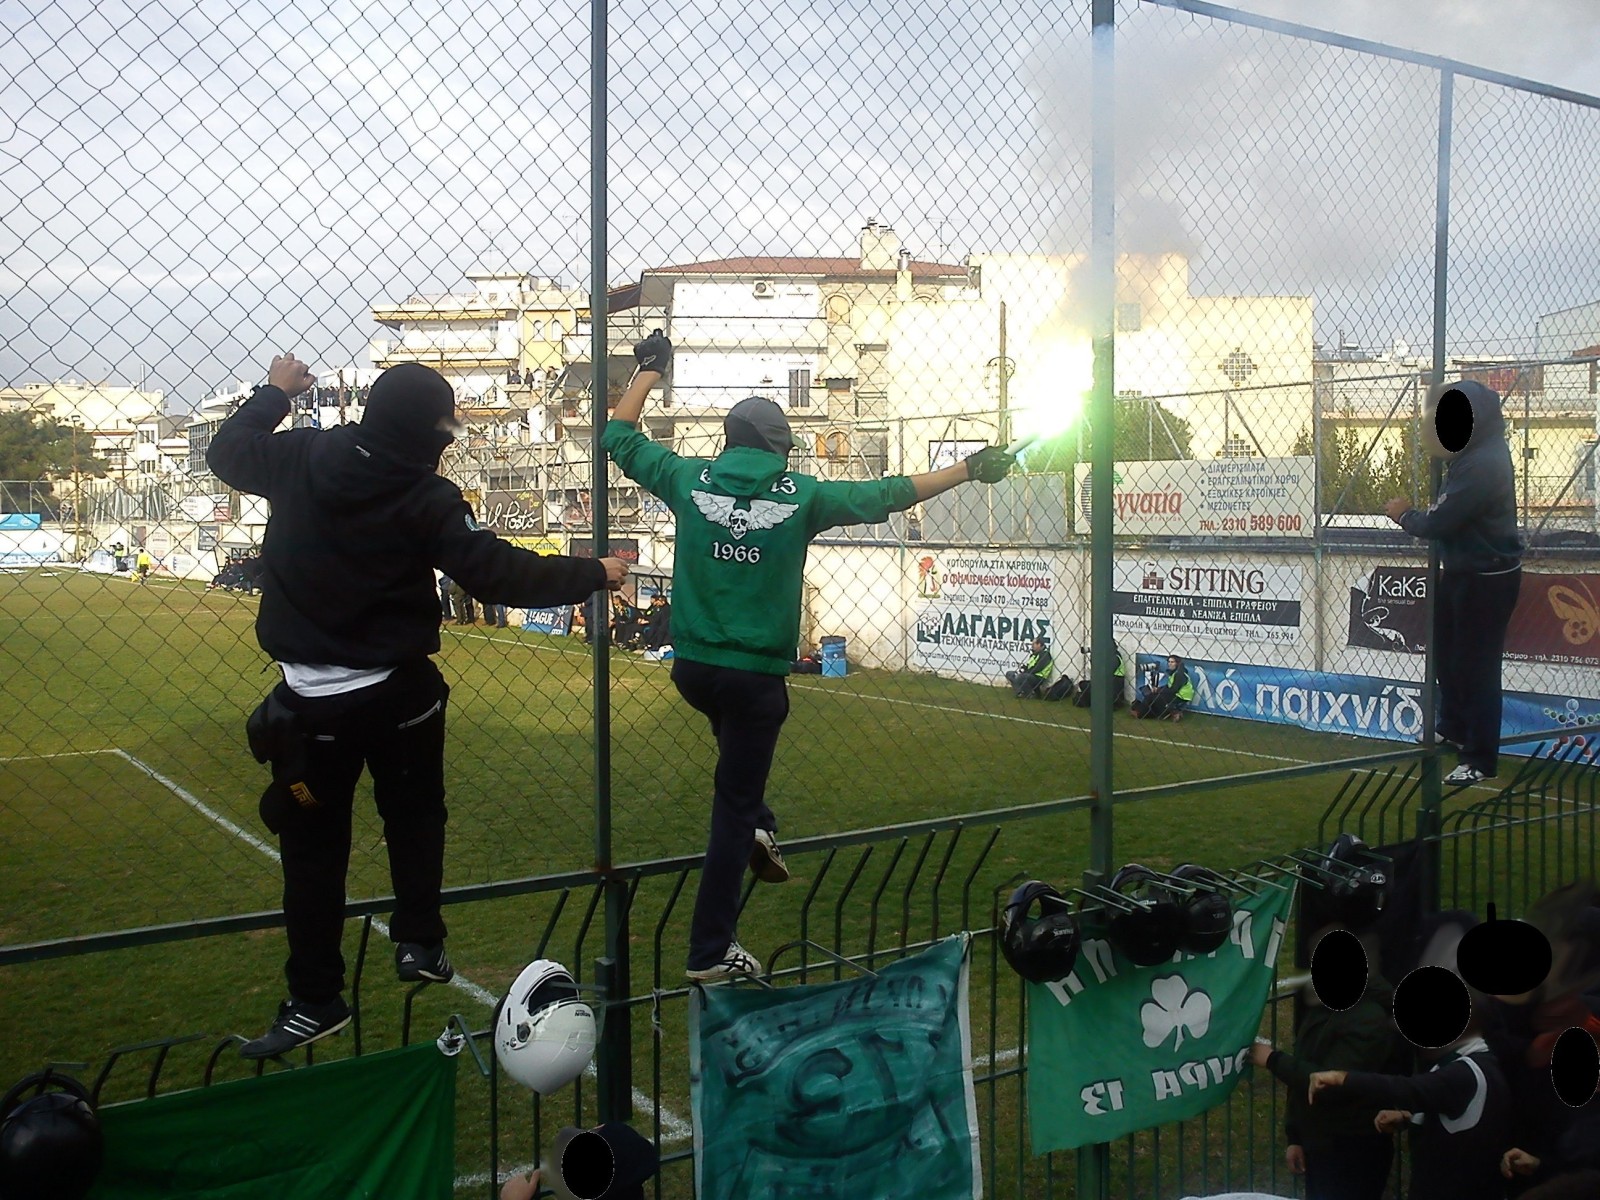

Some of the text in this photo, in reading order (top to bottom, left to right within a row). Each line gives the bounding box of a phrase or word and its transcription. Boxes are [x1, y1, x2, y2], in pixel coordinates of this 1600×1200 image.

[1222, 518, 1246, 531] 2310
[1250, 515, 1274, 531] 589
[1278, 514, 1301, 531] 600
[713, 541, 761, 564] 1966
[946, 559, 1047, 572] ΚΟΤΟΠΟΥΛΑ ΣΤΑ ΚΑΡΒΟΥΝΑ
[1169, 567, 1265, 594] SITTING
[1202, 599, 1233, 609] ΕΠΙΠΛΑ
[1145, 606, 1176, 617] ΠΑΙΔΙΚΑ
[1230, 612, 1262, 623] ΕΠΙΠΛΑ
[942, 613, 1050, 643] ΛΑΓΑΡΙΑΣ
[941, 635, 974, 647] ΤΕΧΝΙΚΗ
[1551, 655, 1569, 663] 2310
